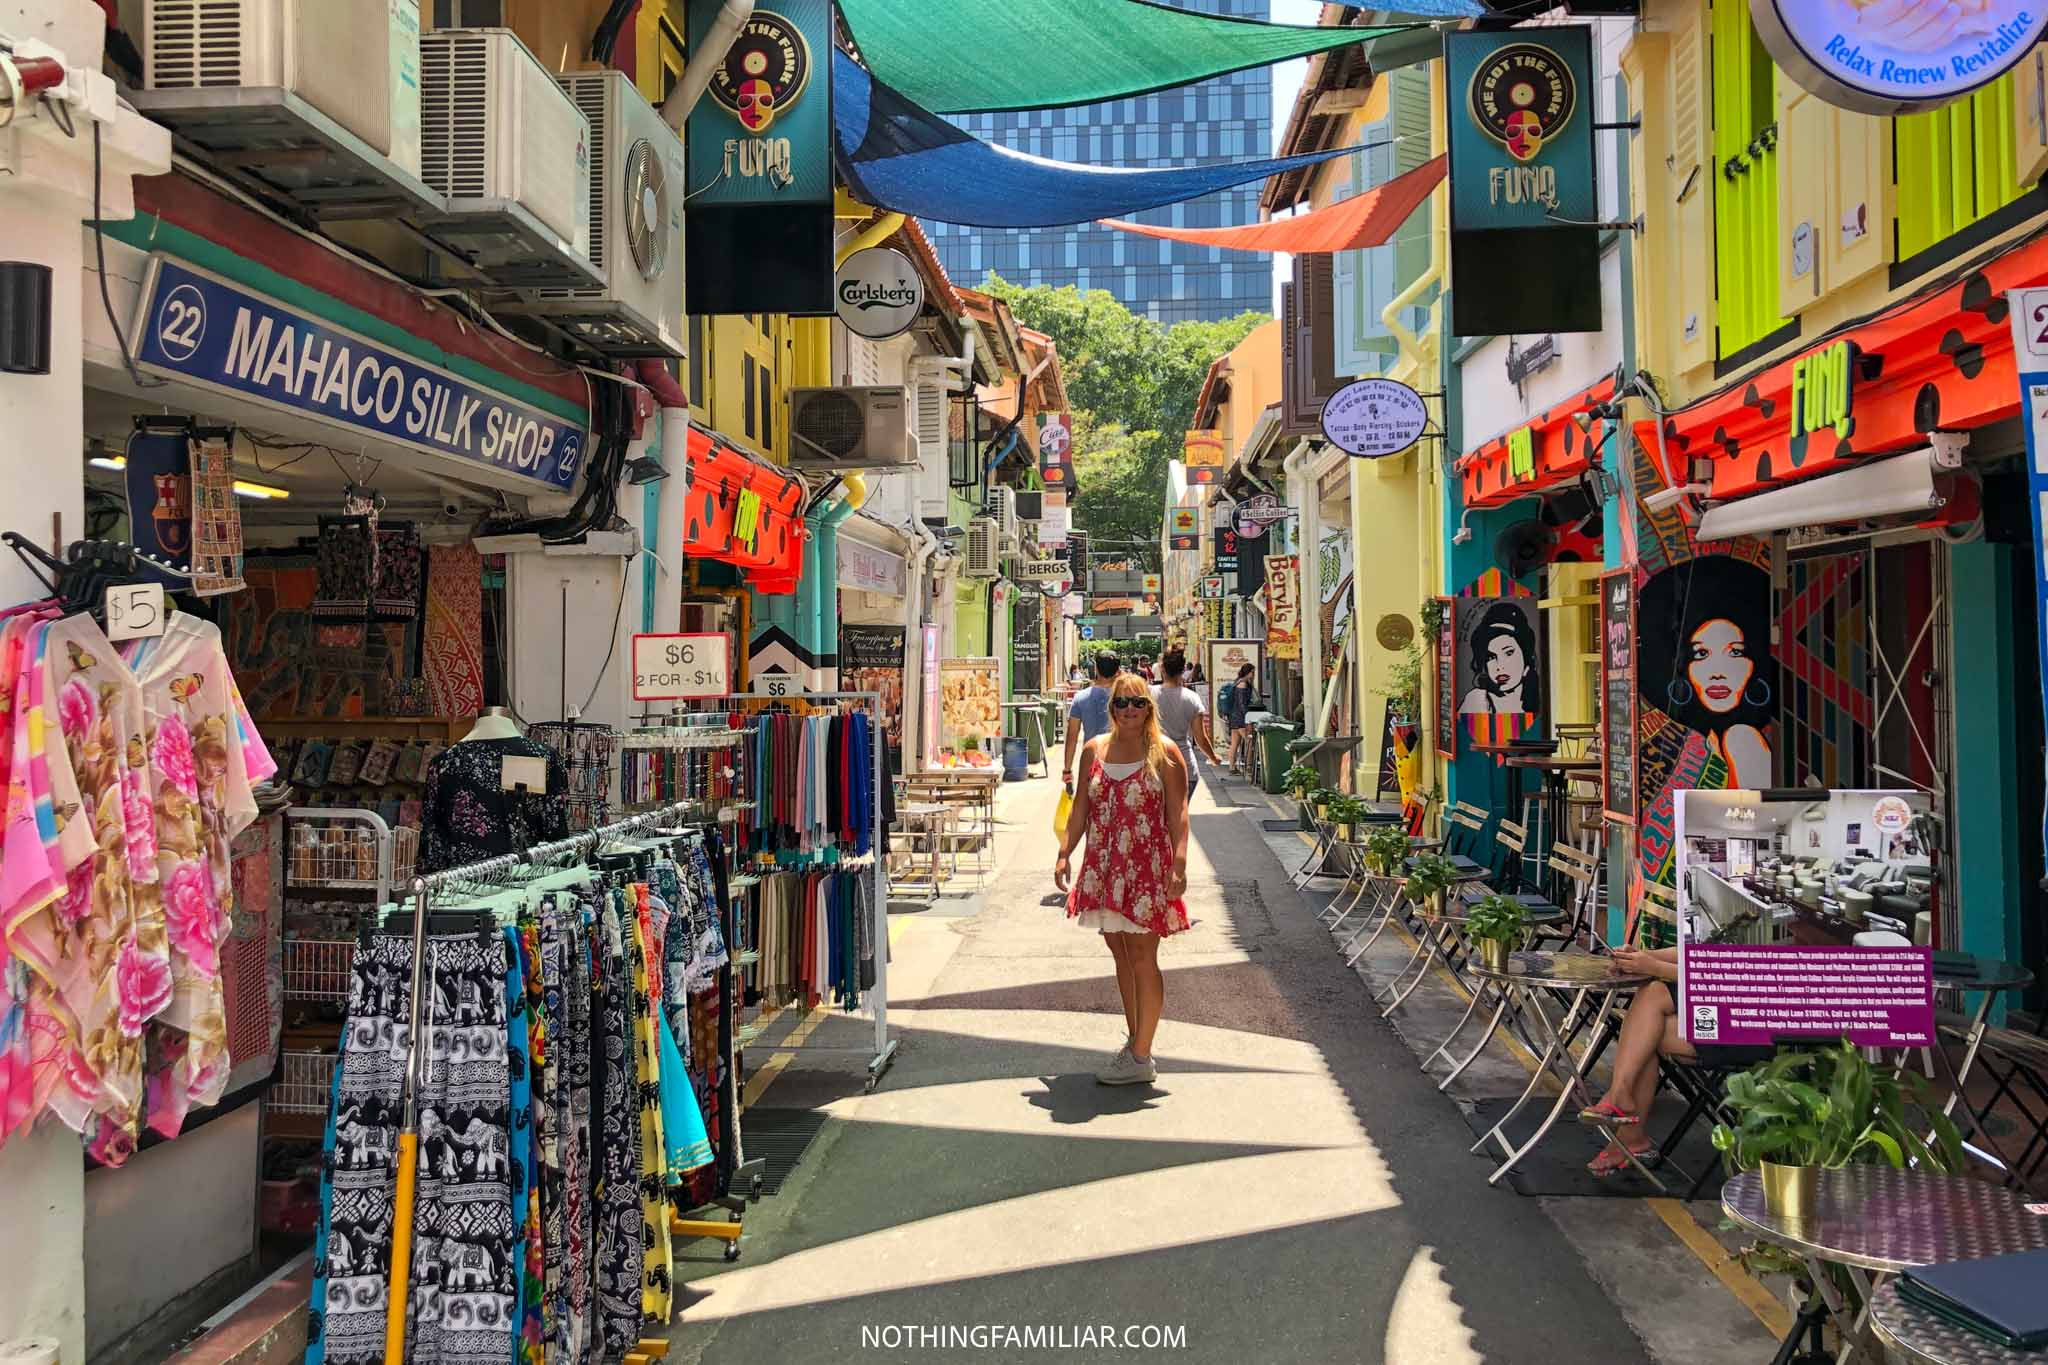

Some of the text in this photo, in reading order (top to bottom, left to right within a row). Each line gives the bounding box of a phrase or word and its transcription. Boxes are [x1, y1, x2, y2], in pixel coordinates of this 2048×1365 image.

[749, 23, 780, 39] THE
[779, 37, 797, 85] FUNK
[1824, 10, 2035, 84] Relax Renew Revitalize
[1483, 55, 1562, 117] WE GOT THE FUNK
[723, 138, 794, 184] FUNQ
[1488, 165, 1560, 210] FUNQ
[838, 279, 916, 305] Carlsberg
[160, 299, 577, 475] 22 MAHACO SILK SHOP 22
[1791, 340, 1850, 440] FUNQ
[1029, 563, 1067, 575] BERGS
[110, 590, 156, 630] $5
[1268, 556, 1294, 625] Beryl's
[665, 644, 694, 667] $6
[636, 674, 645, 687] 2
[649, 673, 681, 687] FOR
[768, 681, 786, 696] $6
[1730, 1008, 1758, 1016] WELCOME
[1790, 1009, 1803, 1017] Lane
[1890, 1032, 1905, 1040] Many
